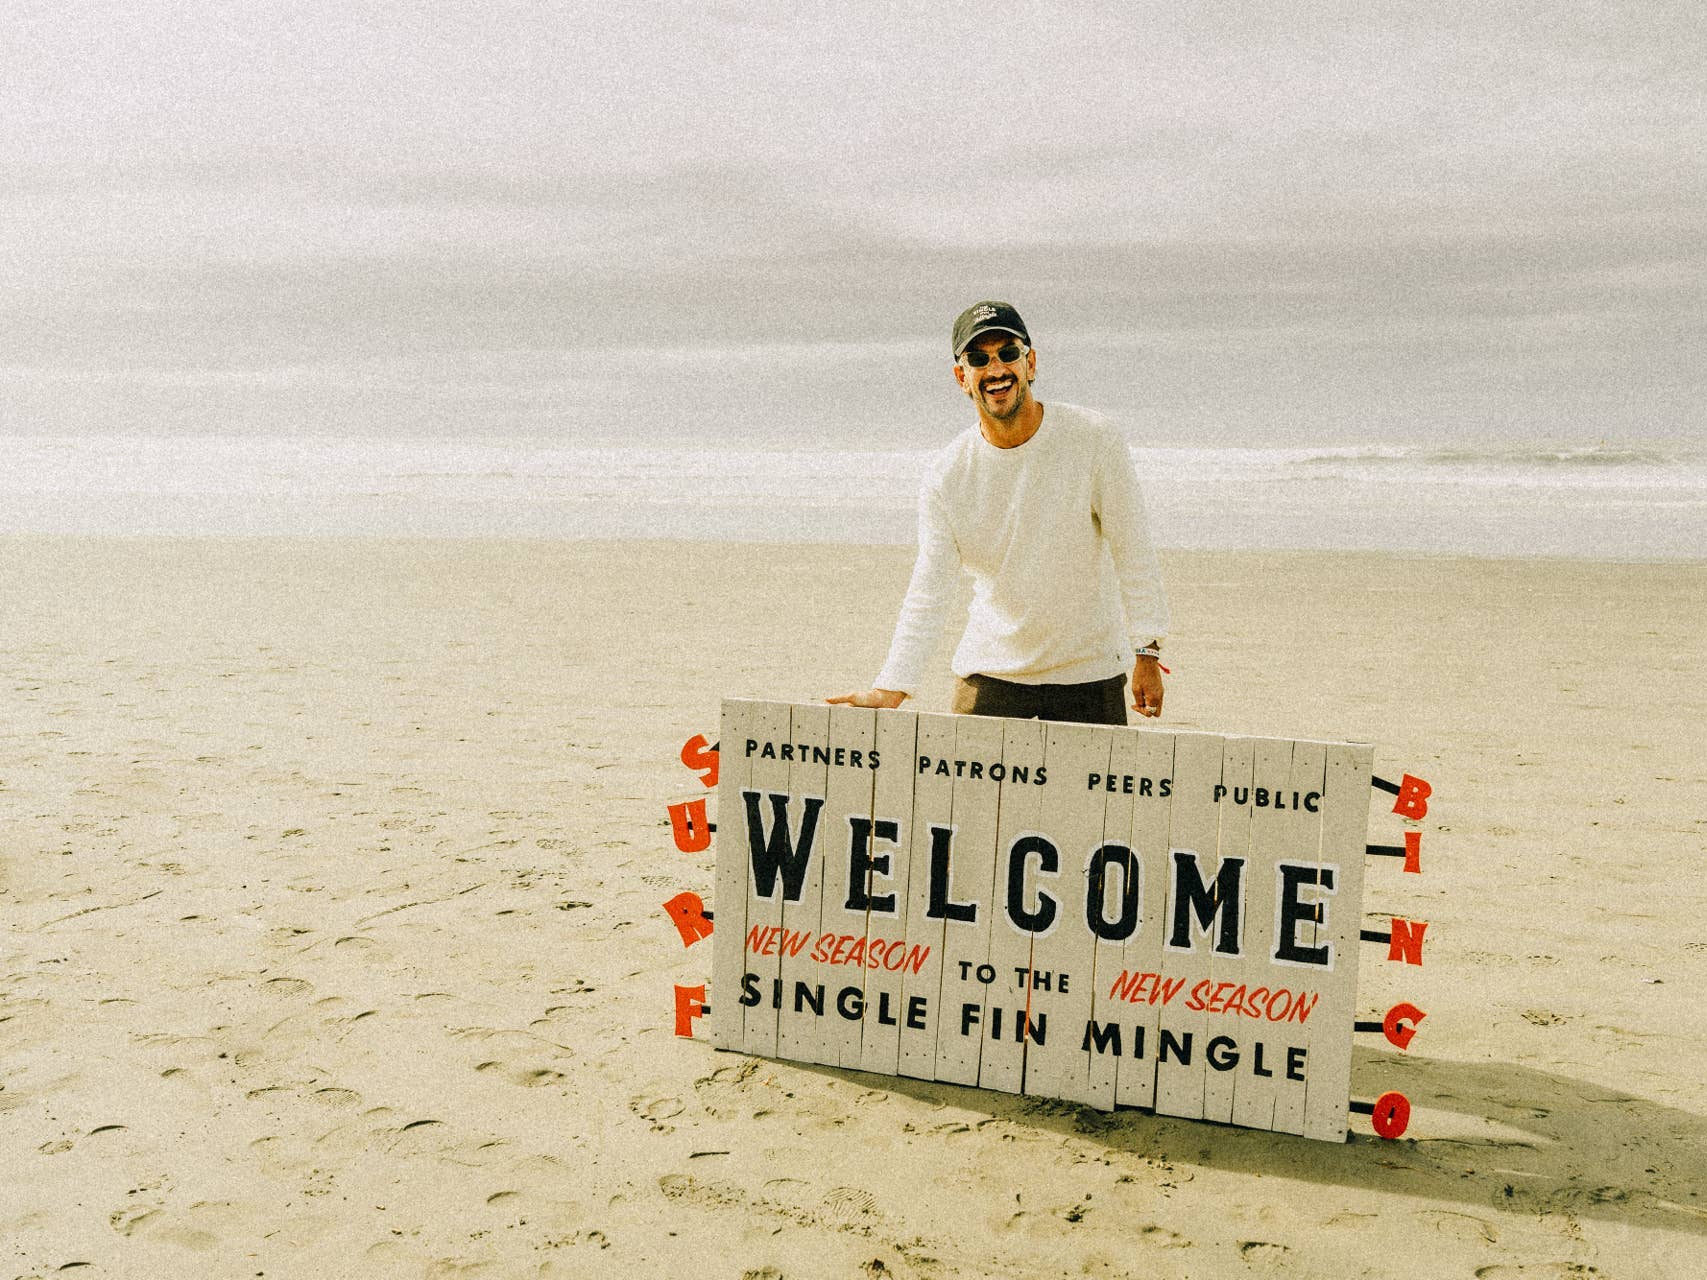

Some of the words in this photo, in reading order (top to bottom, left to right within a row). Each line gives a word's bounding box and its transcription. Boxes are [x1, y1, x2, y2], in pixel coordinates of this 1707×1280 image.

[745, 738, 881, 770] PARTNERS
[918, 755, 1048, 786] PATRONS
[1087, 772, 1173, 798] PEERS
[1213, 783, 1322, 813] PUBLIC
[741, 790, 1335, 967] WELCOME
[744, 924, 812, 957] NEW
[810, 932, 932, 975] SEASON
[958, 960, 997, 984] TO
[1014, 966, 1070, 994] THE
[1371, 773, 1432, 1140] BINGO
[738, 972, 929, 1031] SINGLE
[960, 1002, 1047, 1046] FIN
[1081, 1019, 1309, 1082] MINGLE
[1109, 969, 1187, 1007] NEW
[1184, 979, 1319, 1025] SEASON
